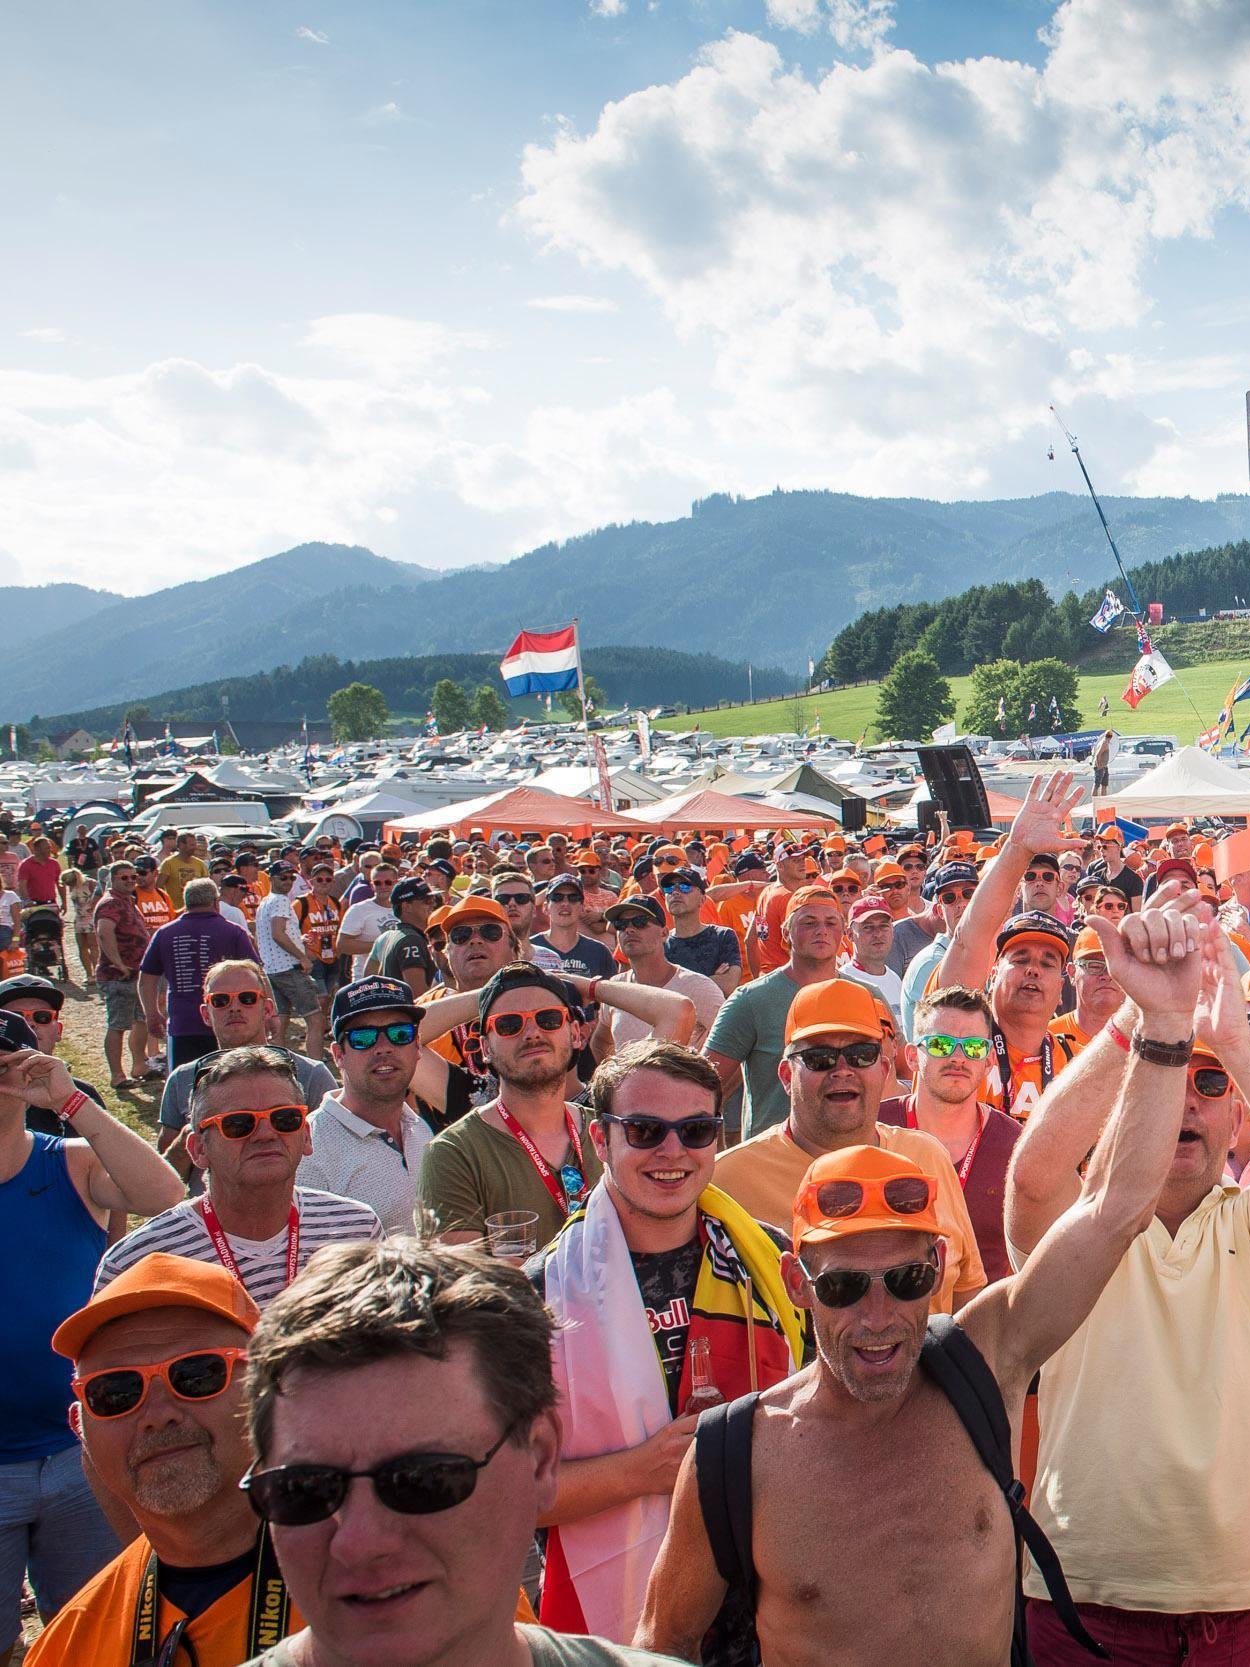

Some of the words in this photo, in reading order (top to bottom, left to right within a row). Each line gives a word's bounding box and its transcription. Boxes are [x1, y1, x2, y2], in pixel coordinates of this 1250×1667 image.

[308, 911, 340, 923] MX
[403, 945, 421, 959] 72
[994, 1034, 1006, 1055] EOS
[986, 1065, 1042, 1115] MA
[139, 1574, 155, 1641] Nikon
[258, 1578, 283, 1646] Nikon
